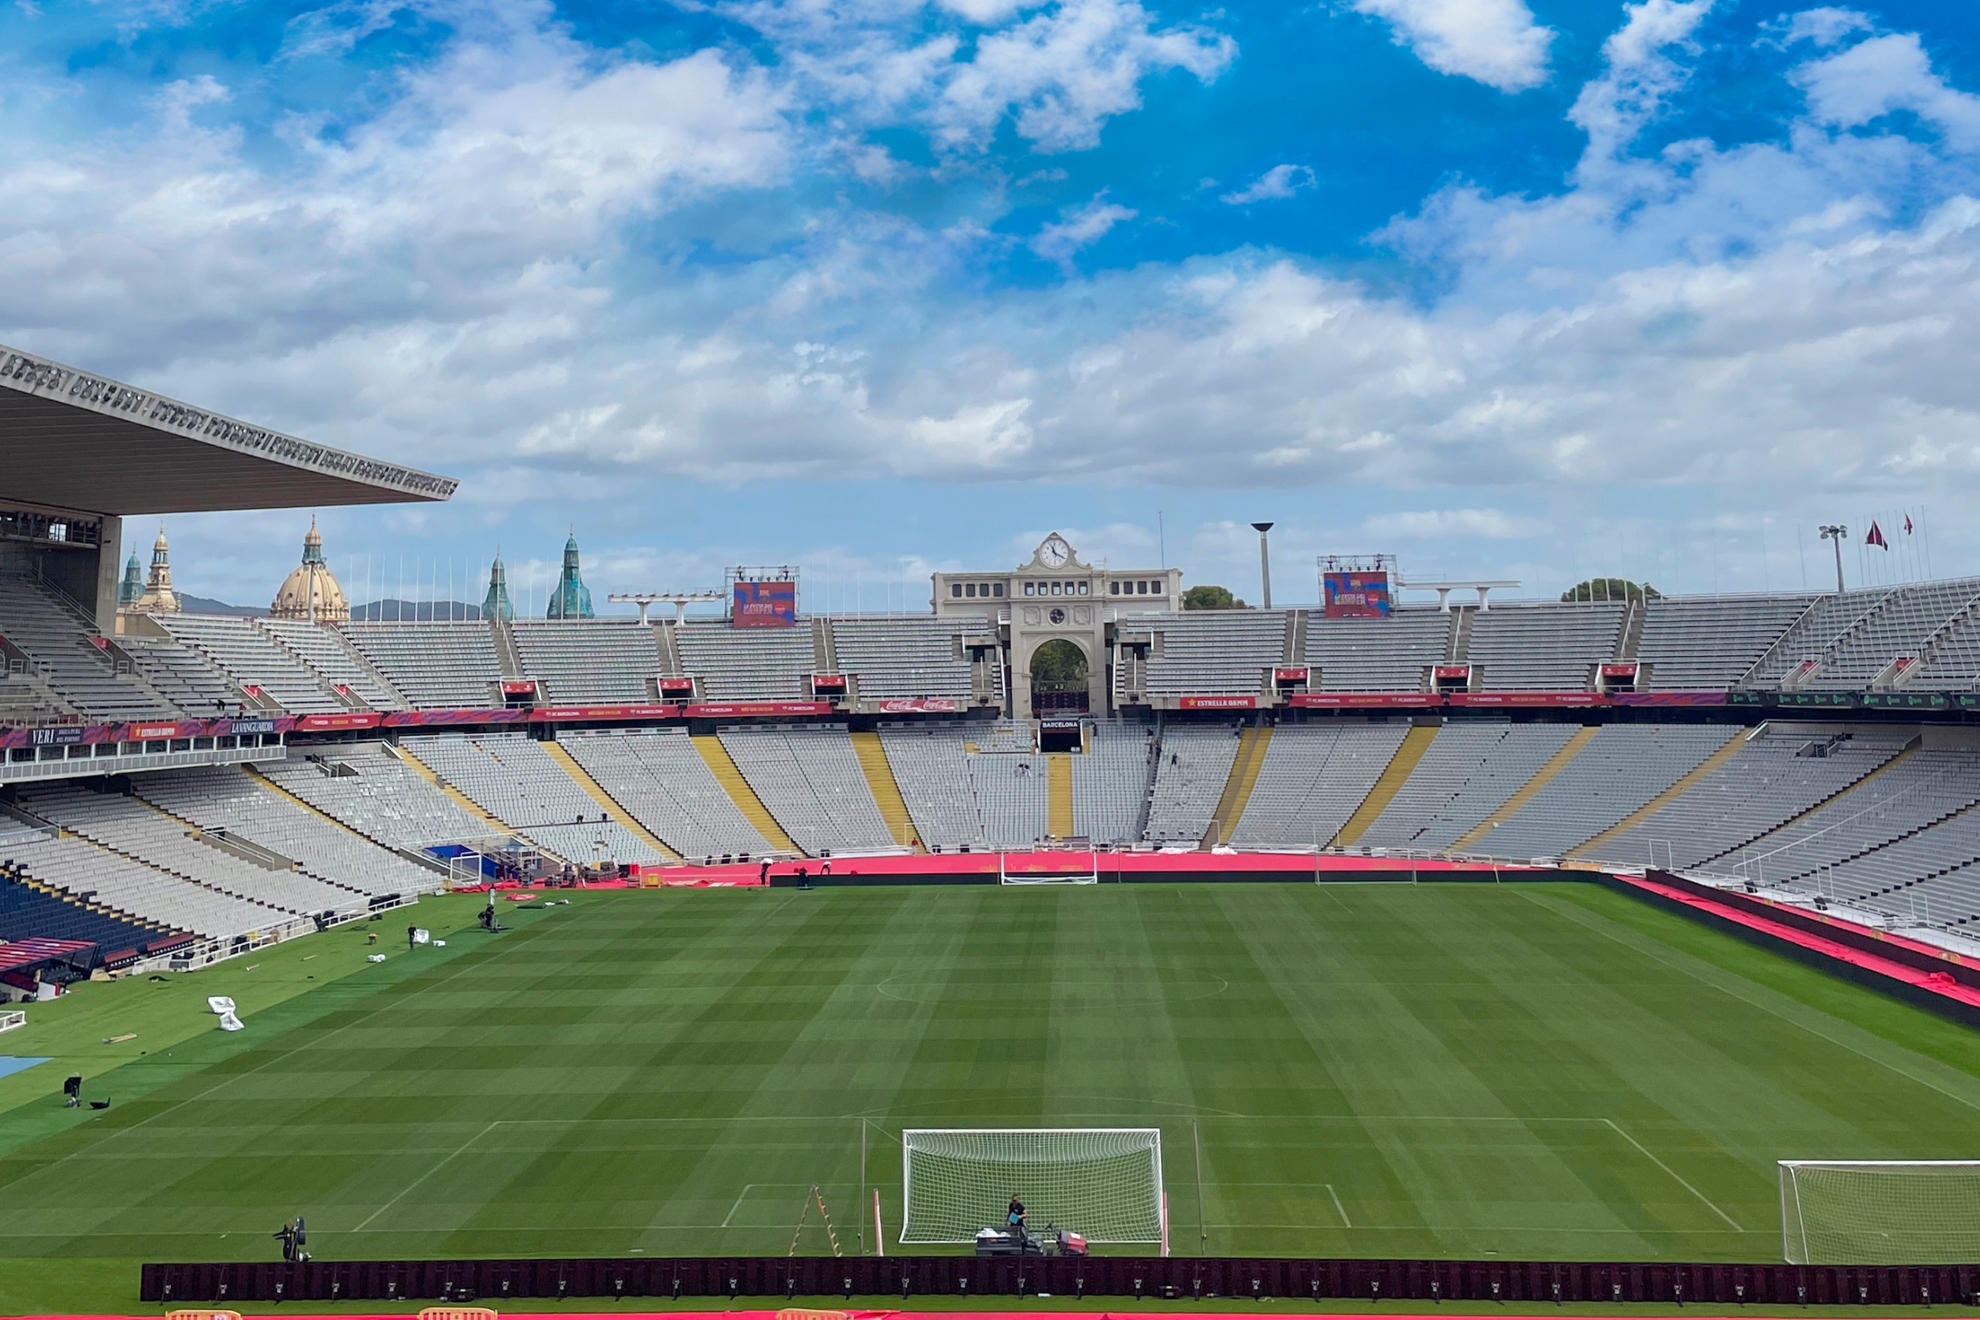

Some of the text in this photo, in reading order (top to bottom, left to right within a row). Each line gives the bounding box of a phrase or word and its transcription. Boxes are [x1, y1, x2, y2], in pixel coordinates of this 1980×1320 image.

[886, 700, 912, 710] Coca-Cola
[923, 700, 949, 710] Coca-Cola
[33, 729, 55, 744] VERI
